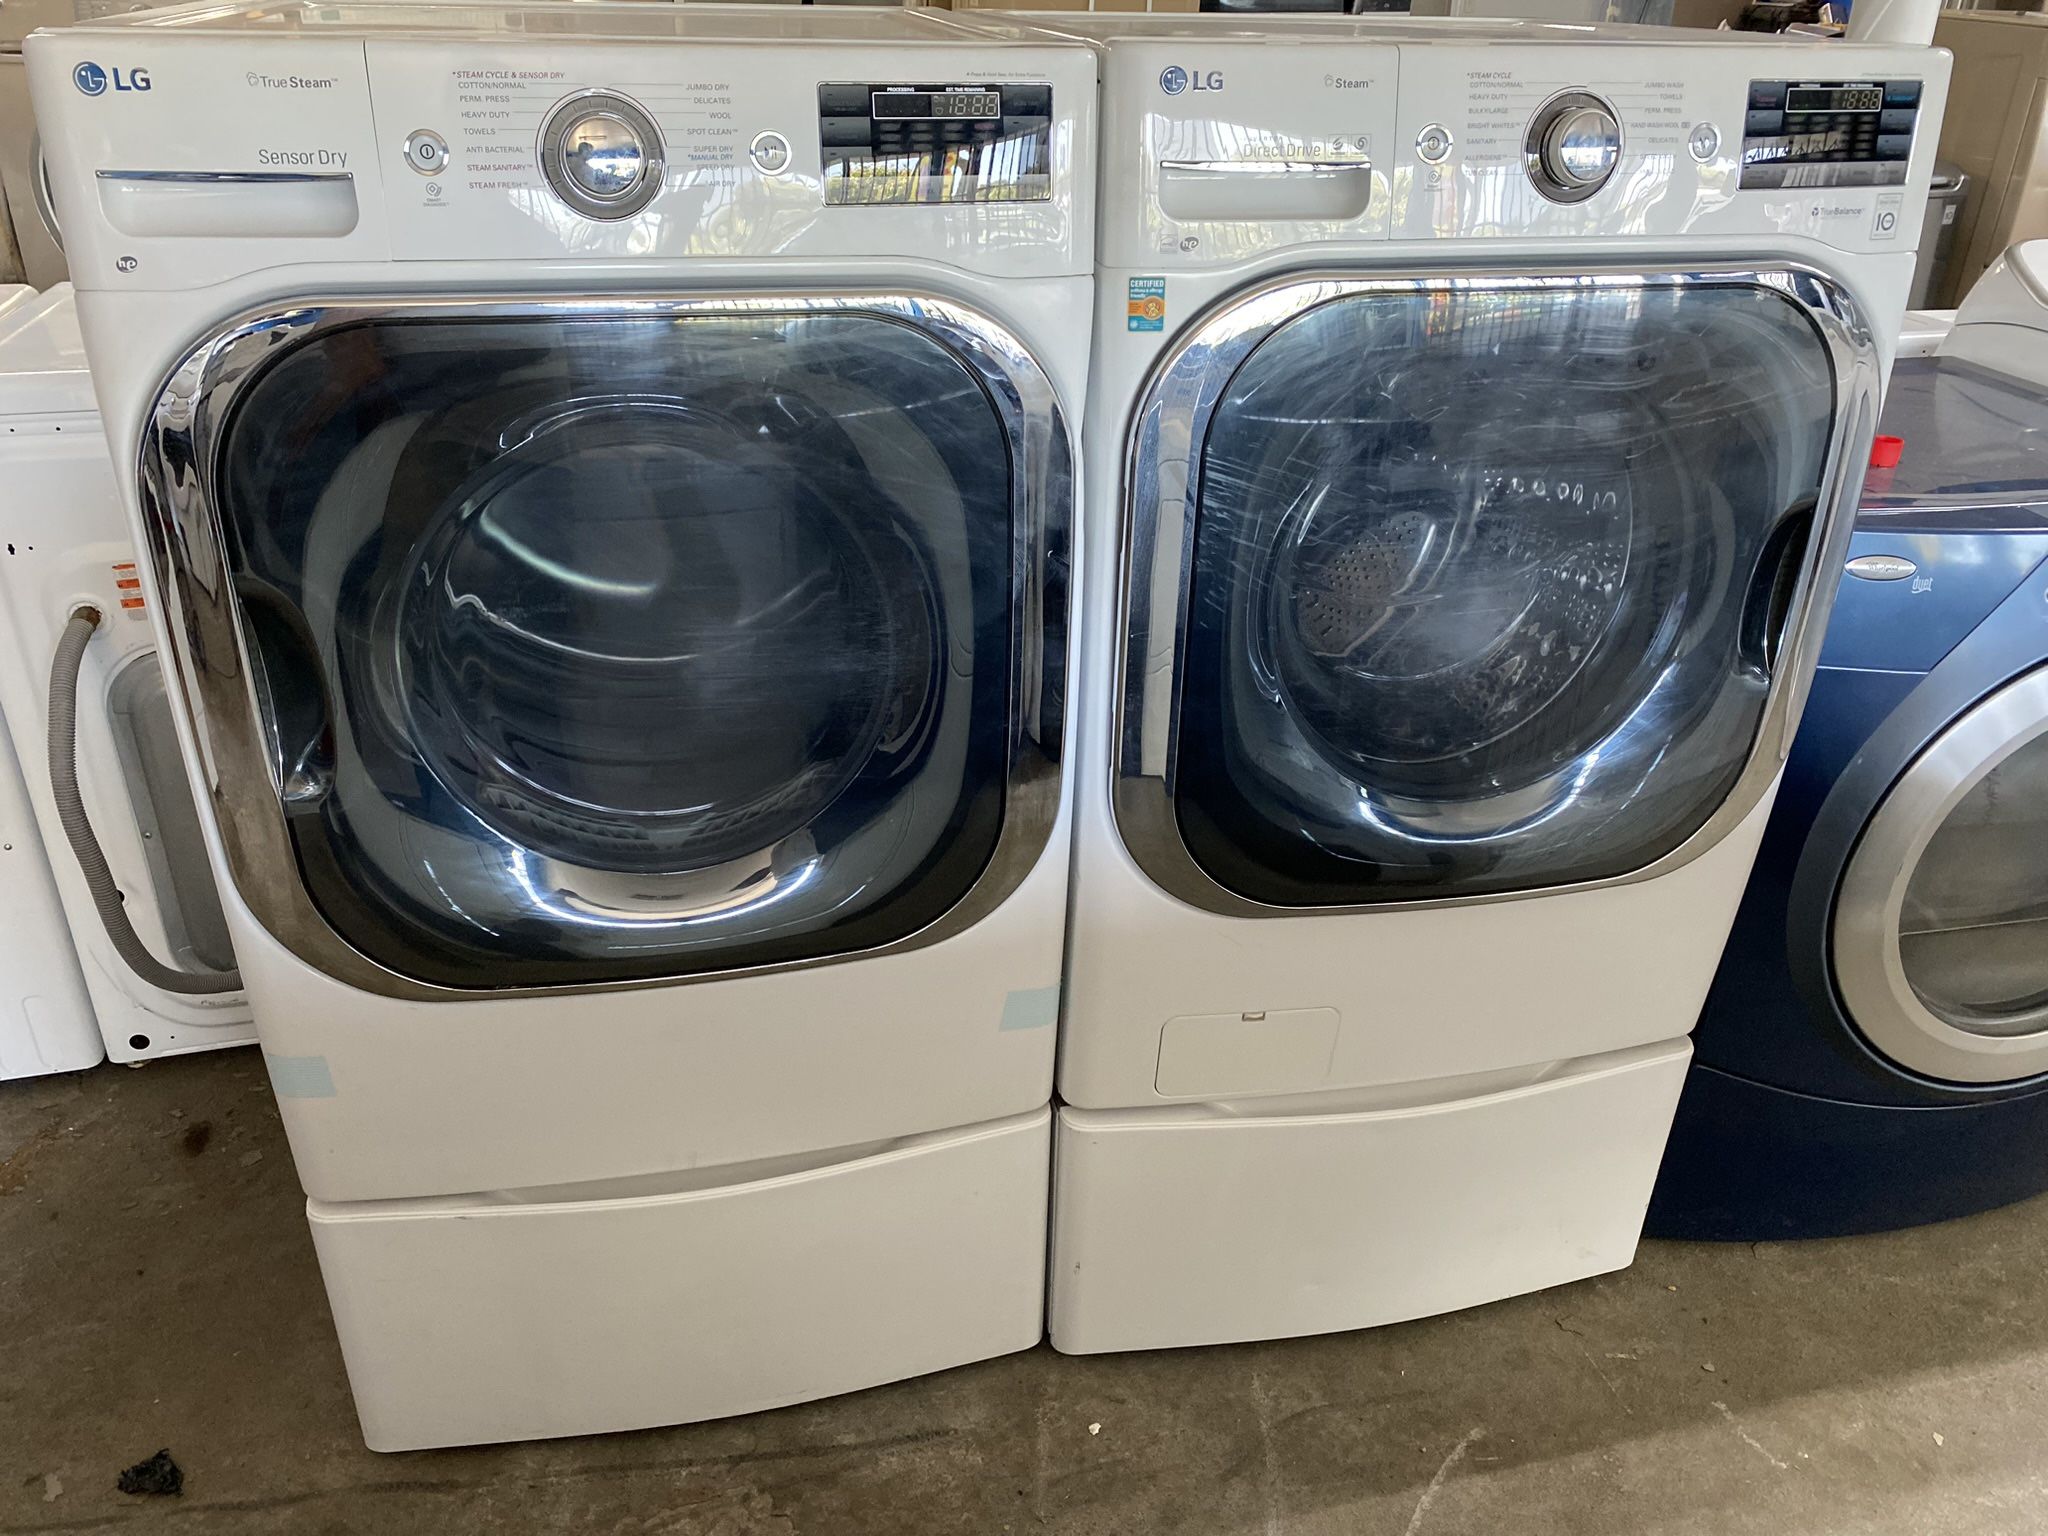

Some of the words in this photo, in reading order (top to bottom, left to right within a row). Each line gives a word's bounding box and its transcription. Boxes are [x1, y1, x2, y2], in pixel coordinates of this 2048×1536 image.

[112, 67, 151, 91] LG
[485, 71, 509, 79] CYCLE
[511, 71, 517, 79] &
[259, 76, 287, 88] True
[1193, 71, 1223, 91] LG
[686, 83, 713, 91] JUMBO
[714, 83, 730, 91] DRY
[459, 95, 482, 103] PERM.
[485, 95, 510, 103] PRESS
[693, 97, 731, 105] DELICATES
[1469, 93, 1489, 101] HEAVY
[1490, 93, 1508, 101] DUTY
[463, 127, 496, 135] TOWELS
[686, 128, 706, 136] SPOT
[466, 146, 483, 154] ANTI
[485, 146, 525, 154] BACTERIAL
[1243, 143, 1284, 158] Direct
[1286, 143, 1320, 157] Drive
[258, 149, 314, 165] Sensor
[318, 149, 348, 168] Dry
[467, 164, 491, 172] STEAM
[469, 182, 495, 190] STEAM
[1130, 279, 1164, 288] CERTIFIED
